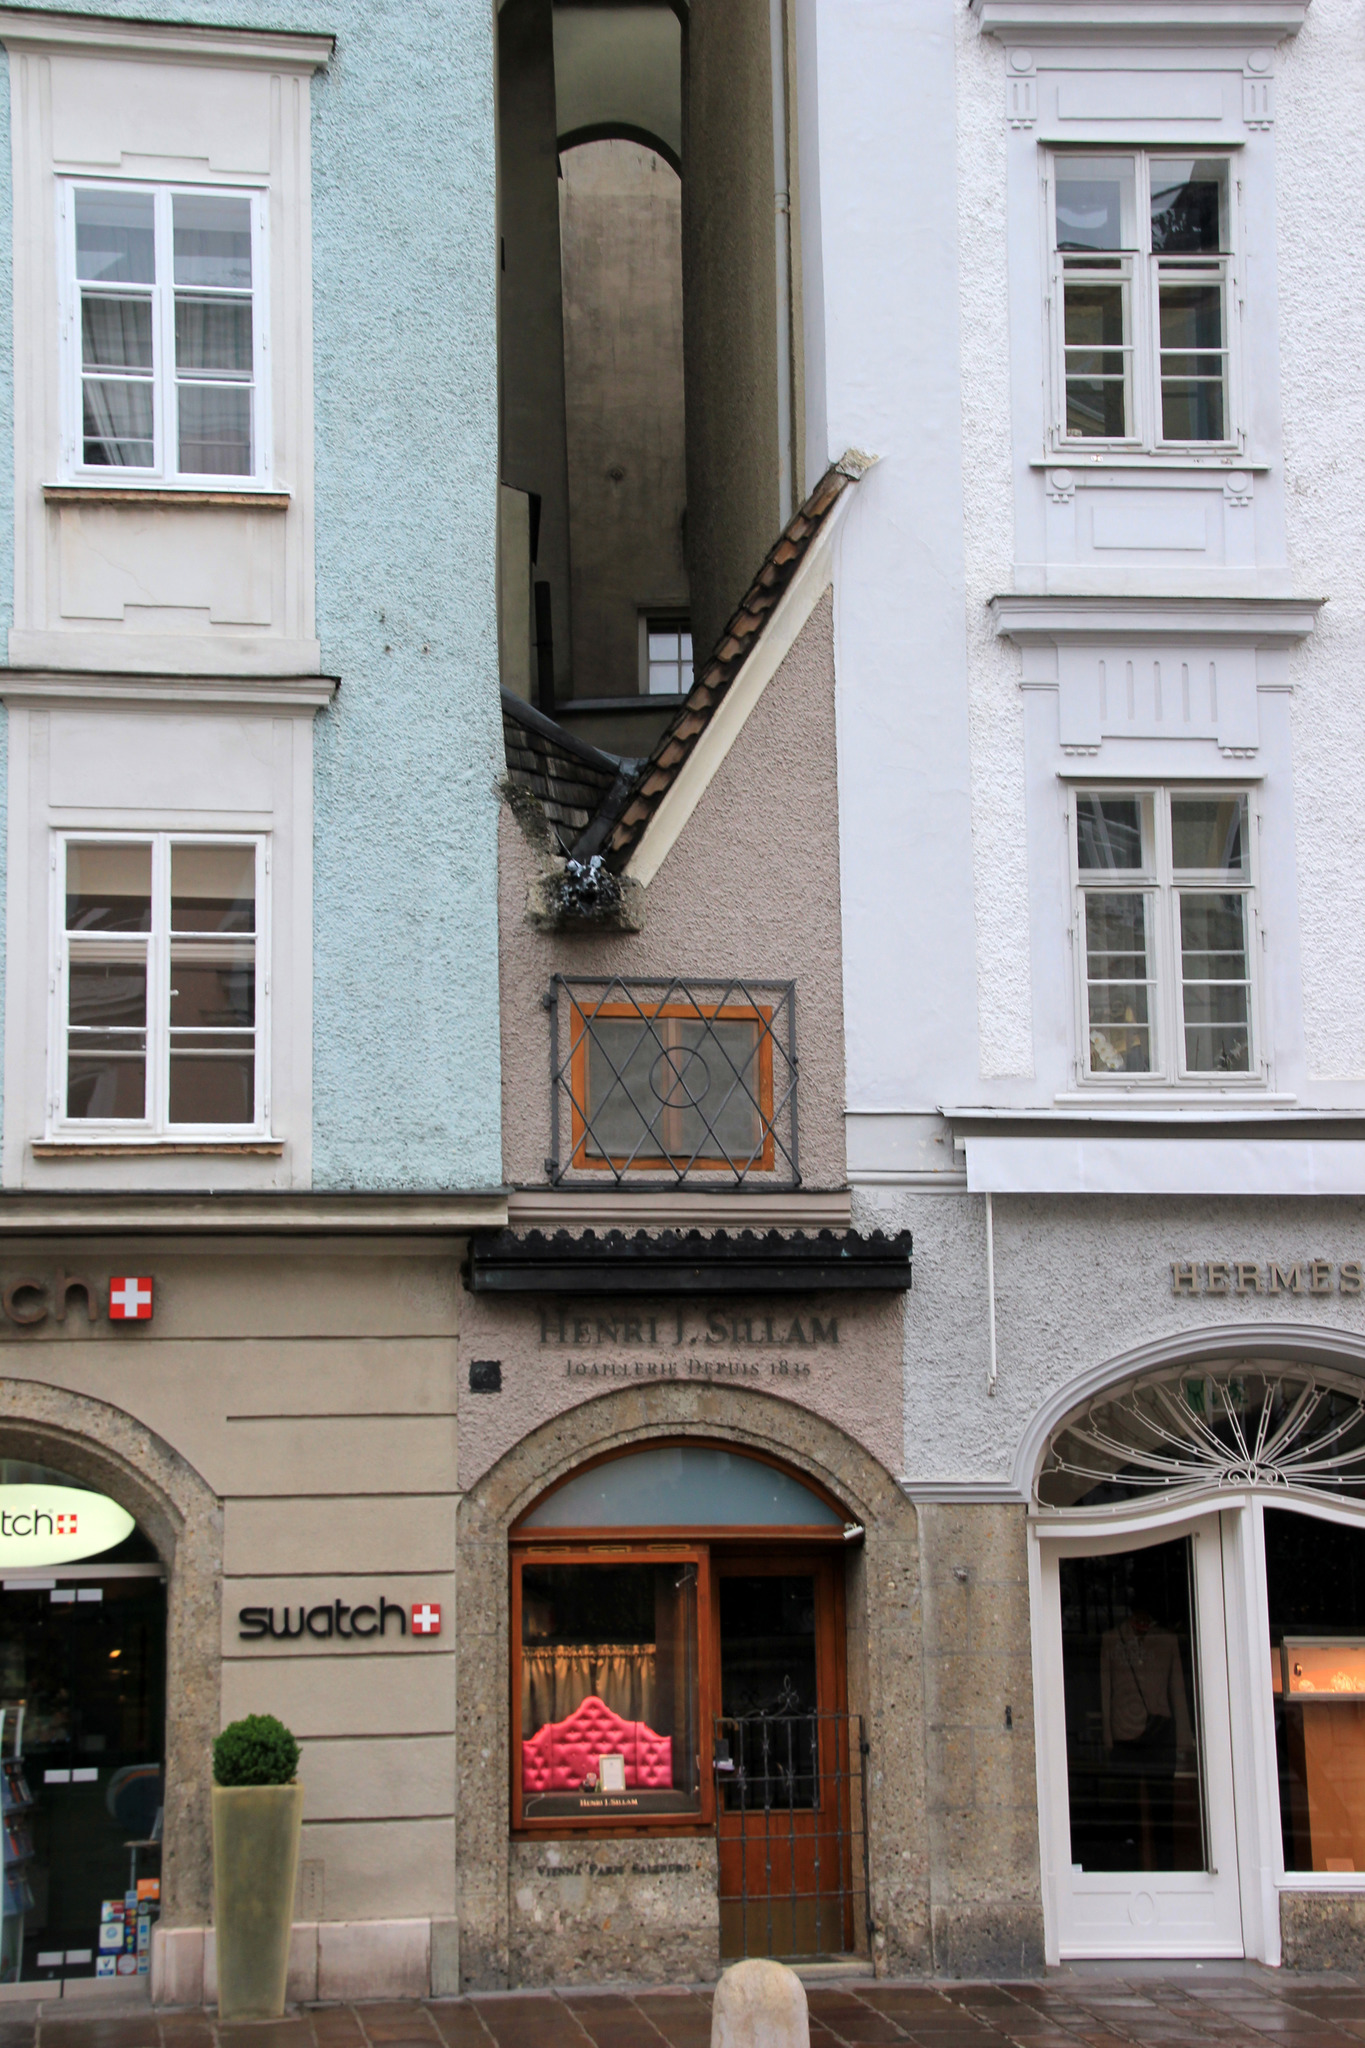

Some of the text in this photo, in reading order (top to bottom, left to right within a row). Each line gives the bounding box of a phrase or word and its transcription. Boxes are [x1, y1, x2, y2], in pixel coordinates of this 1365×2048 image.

[1170, 1257, 1364, 1294] HERMÈS
[540, 1308, 840, 1346] HENRI J. SILLAM
[565, 1358, 812, 1377] JOAILLERIE DEPUIS 1835
[239, 1596, 408, 1640] swatch
